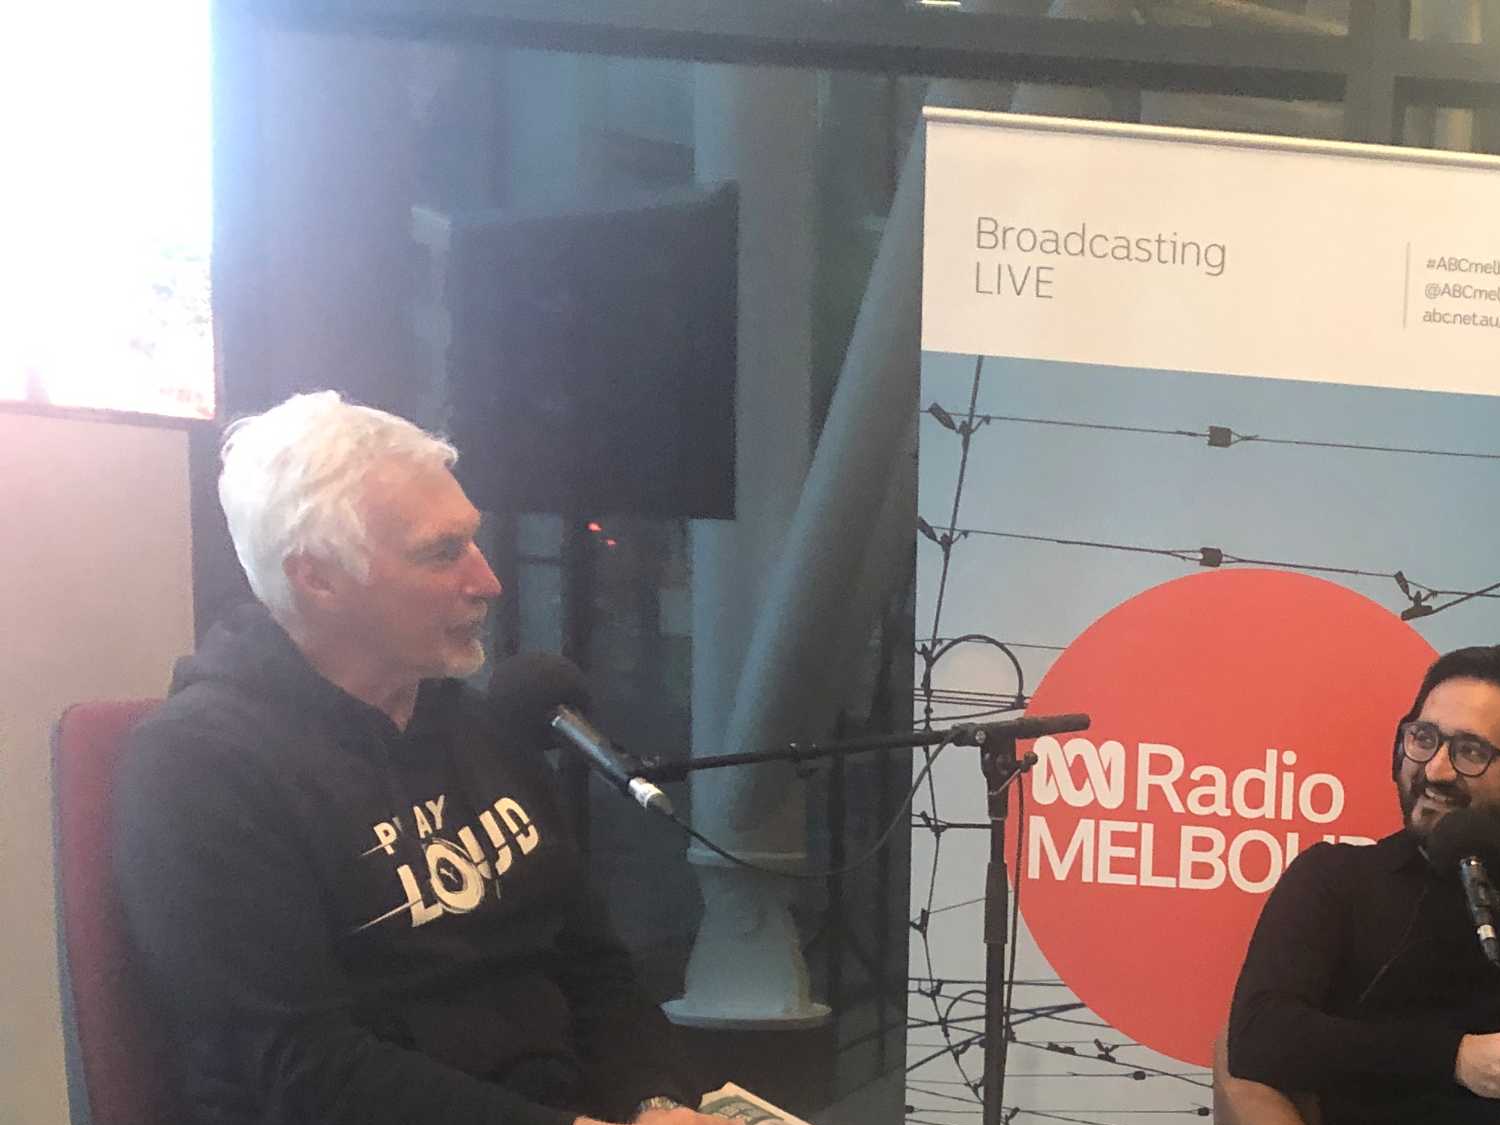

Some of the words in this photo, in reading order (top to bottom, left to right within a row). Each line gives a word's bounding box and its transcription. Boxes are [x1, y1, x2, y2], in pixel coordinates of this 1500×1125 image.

[975, 261, 1054, 299] LIVE
[976, 216, 1226, 277] Broadcasting
[1135, 741, 1345, 824] Radio
[396, 796, 541, 928] LOUD
